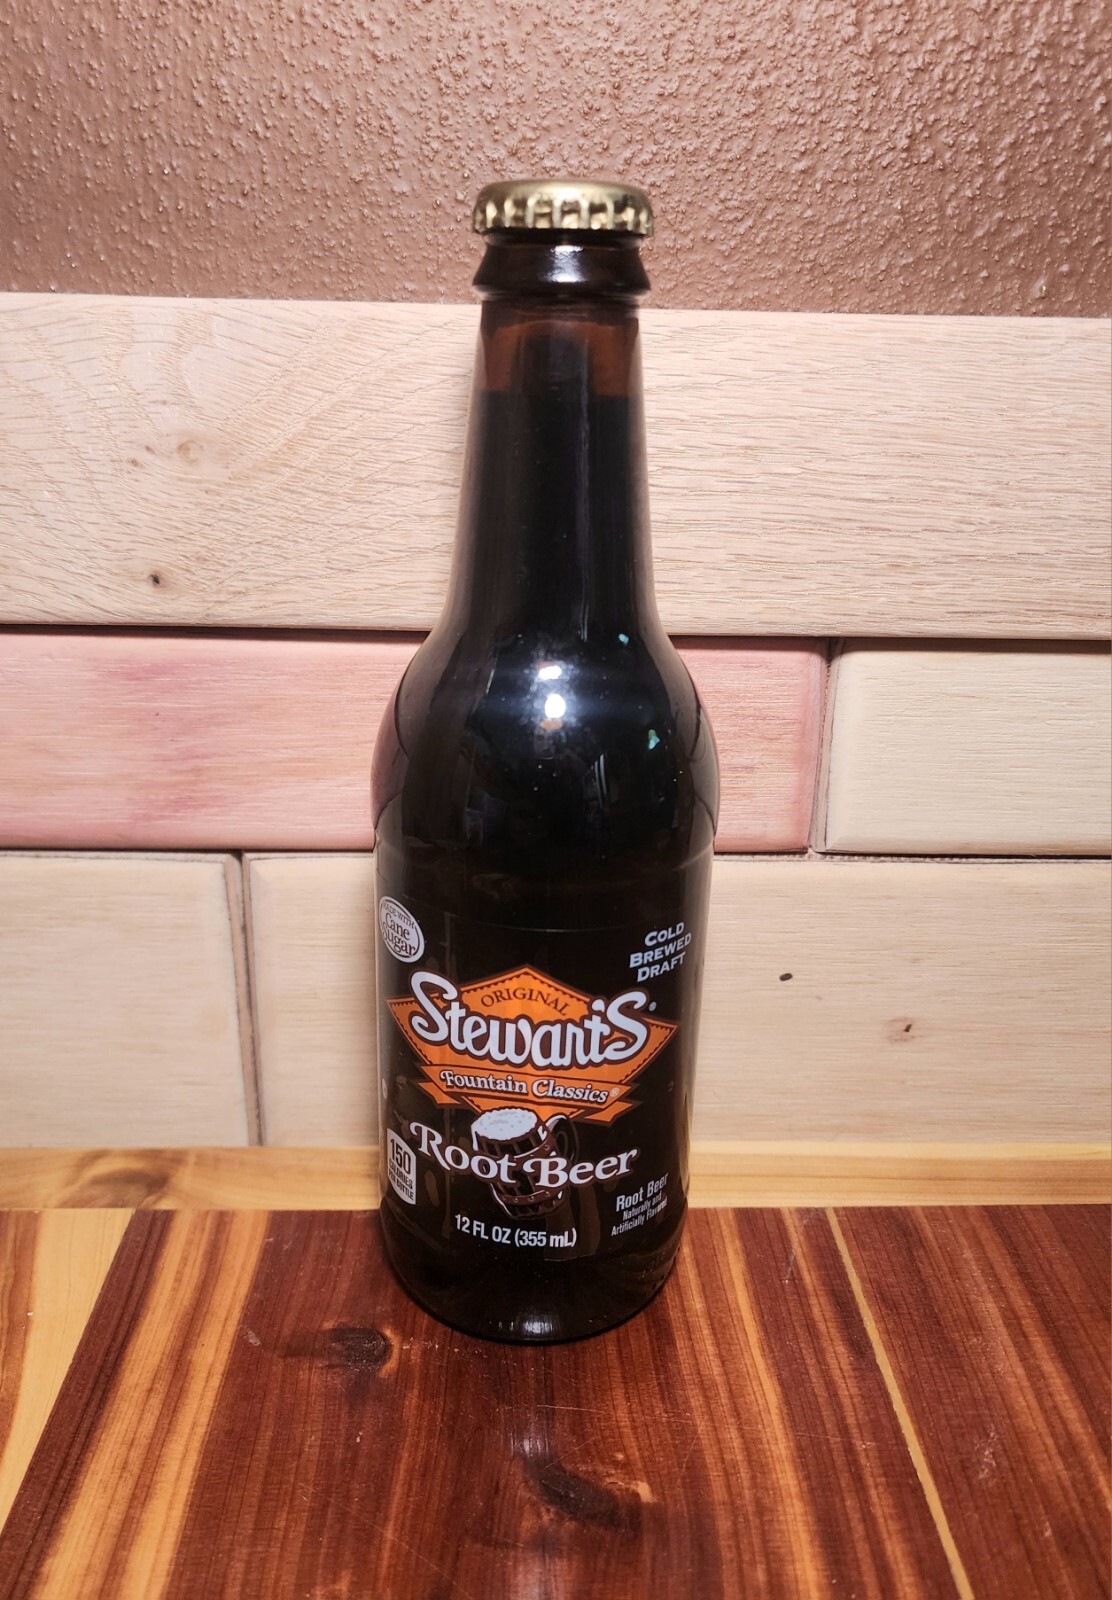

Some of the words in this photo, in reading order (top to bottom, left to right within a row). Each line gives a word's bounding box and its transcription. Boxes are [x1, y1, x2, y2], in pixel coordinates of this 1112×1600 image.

[386, 912, 410, 940] Cane
[397, 911, 415, 929] WITH
[644, 922, 685, 946] COLD
[382, 921, 415, 956] Sugar
[629, 932, 692, 968] BREWED
[637, 951, 686, 982] DRAFT
[481, 987, 571, 1016] ORIGINAL
[440, 1070, 528, 1094] Fountain
[391, 1138, 411, 1175] 150
[409, 1121, 517, 1184] Root
[523, 1148, 638, 1188] Beer
[388, 1158, 413, 1190] CALORIES
[388, 1167, 396, 1183] PER
[397, 1178, 414, 1201] BOTTLE
[615, 1187, 644, 1212] Root
[646, 1172, 669, 1198] Beer
[623, 1200, 651, 1221] Naturally
[652, 1189, 663, 1206] and
[455, 1213, 471, 1233] 12
[472, 1222, 489, 1240] FL
[491, 1227, 511, 1245] OZ
[514, 1228, 547, 1247] (355
[549, 1227, 577, 1248] mL)
[611, 1214, 645, 1237] Artificially
